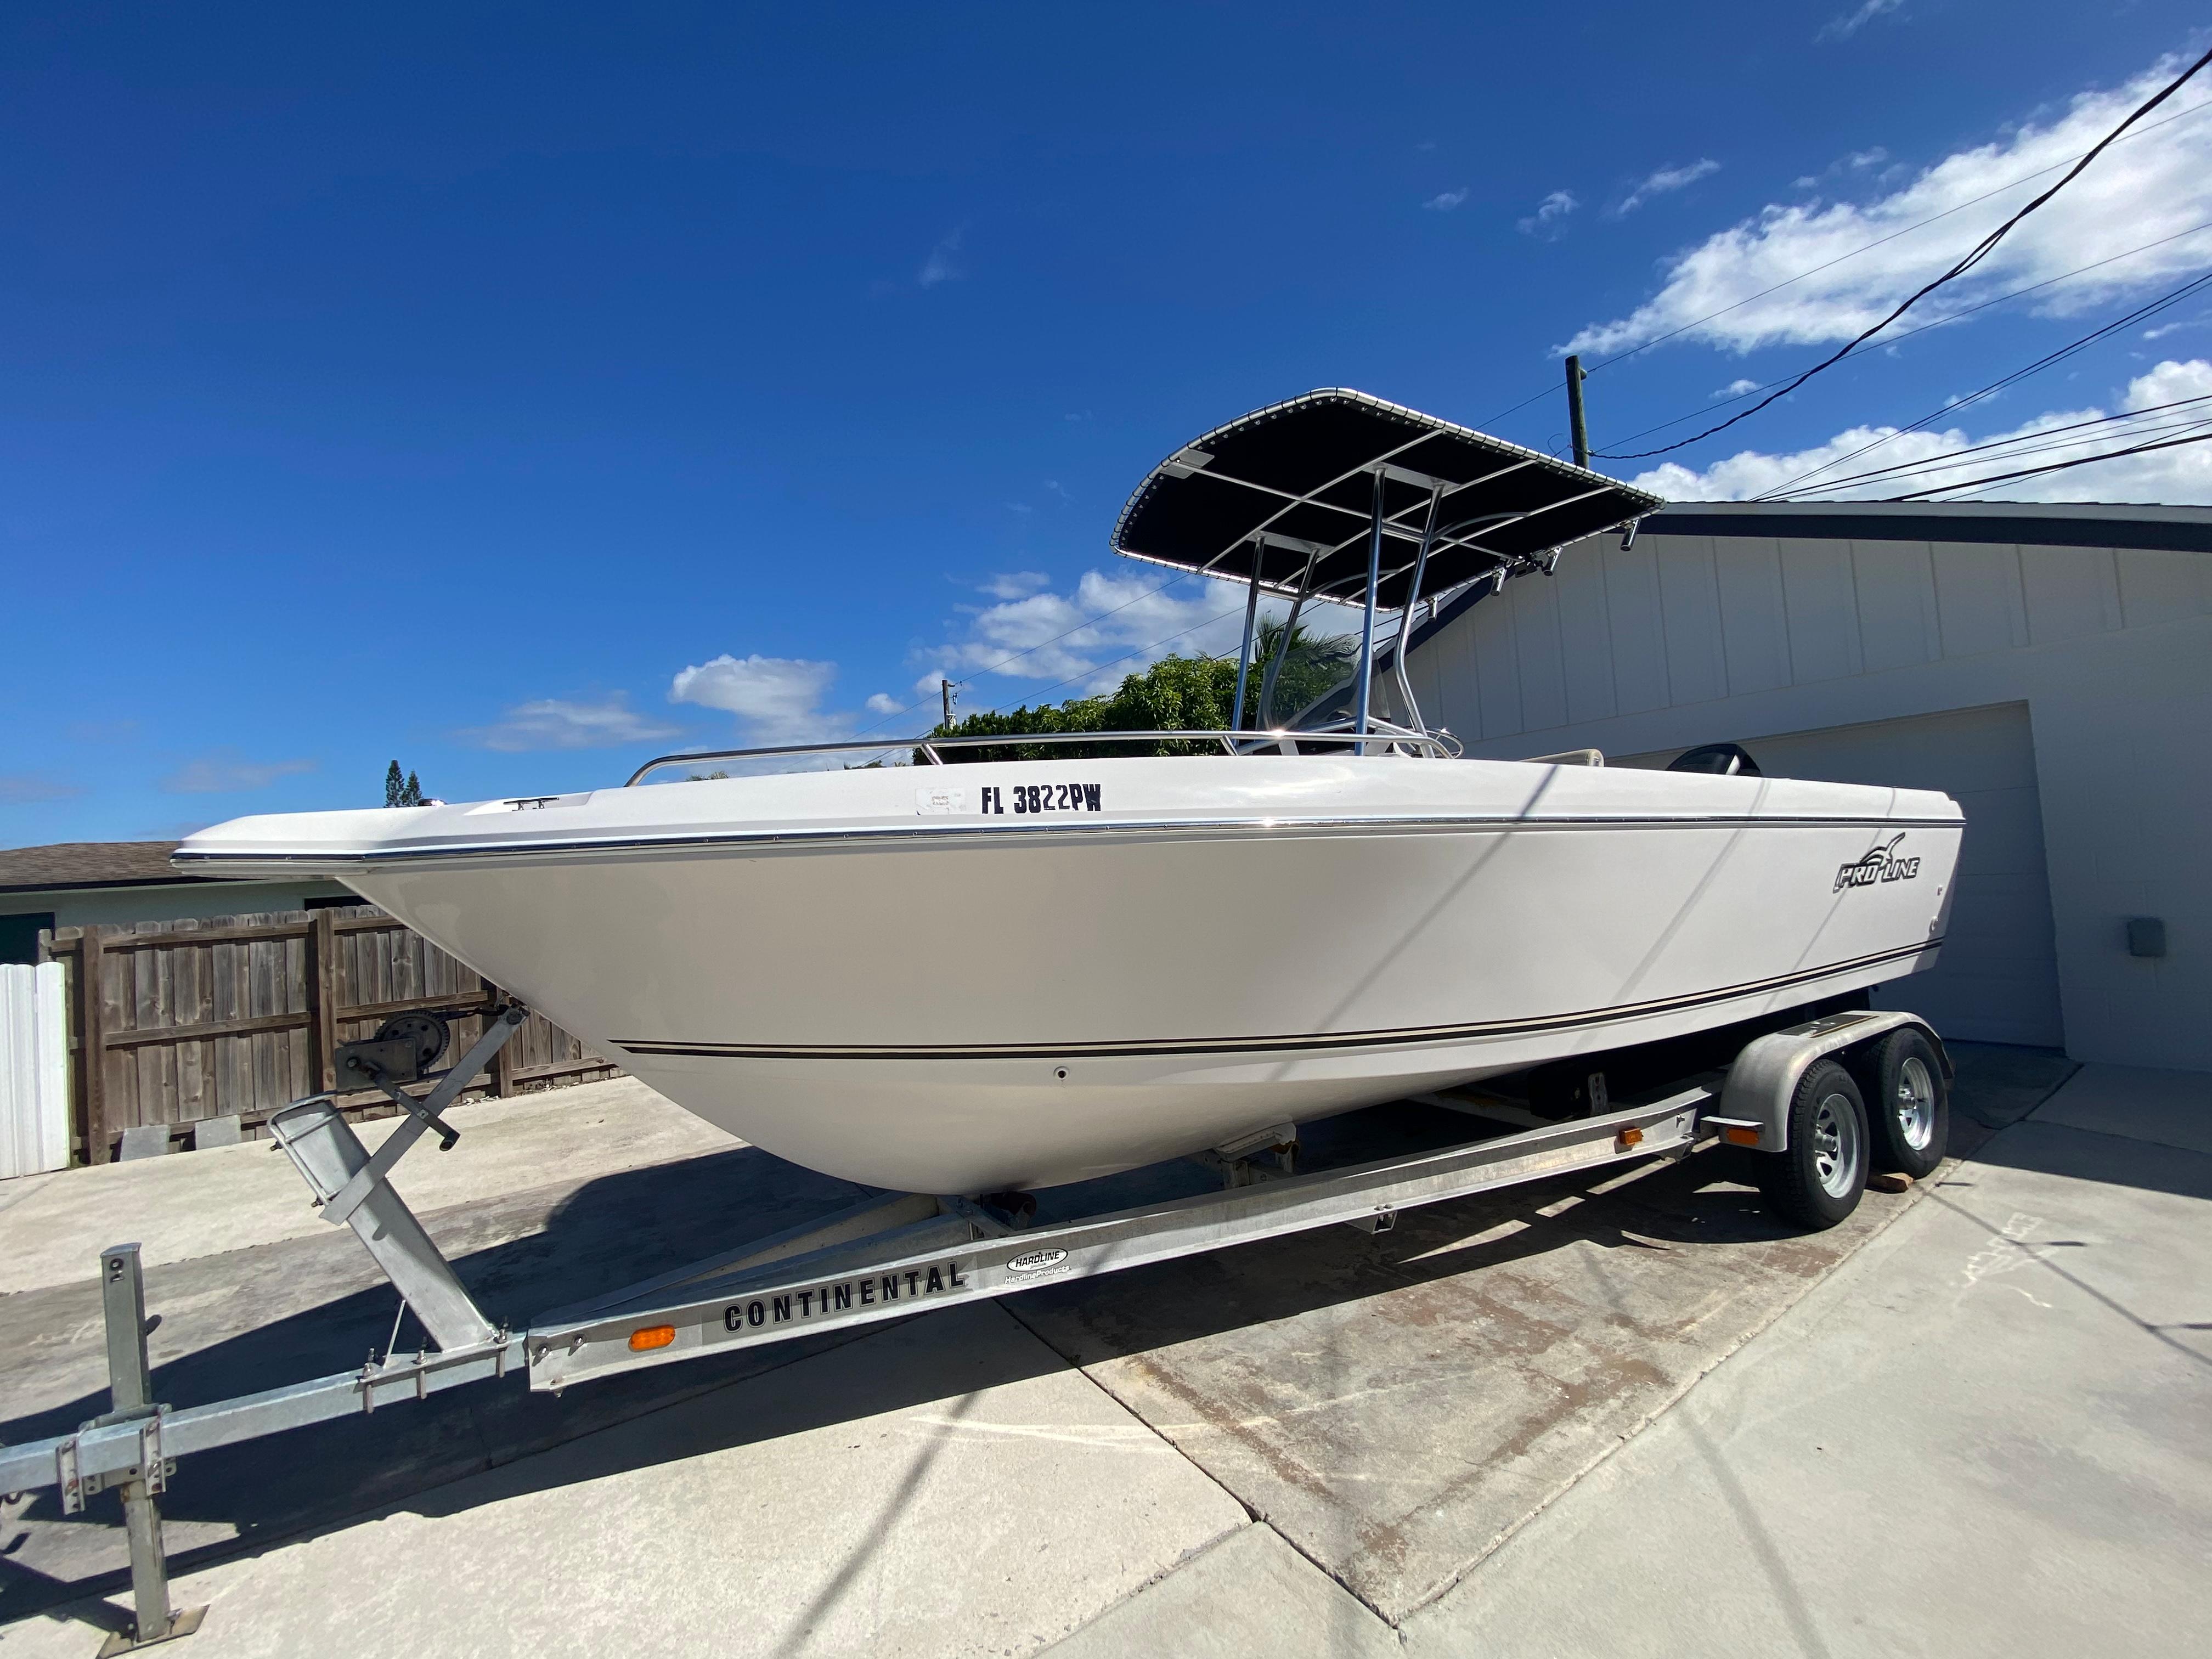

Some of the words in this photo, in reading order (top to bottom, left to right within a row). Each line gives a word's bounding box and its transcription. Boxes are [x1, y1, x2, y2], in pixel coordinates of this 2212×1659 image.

[981, 787, 1004, 814] FL
[1013, 783, 1101, 814] 3822PW
[1015, 1251, 1060, 1267] HARDLINE
[723, 1261, 966, 1333] CONTINENTAL
